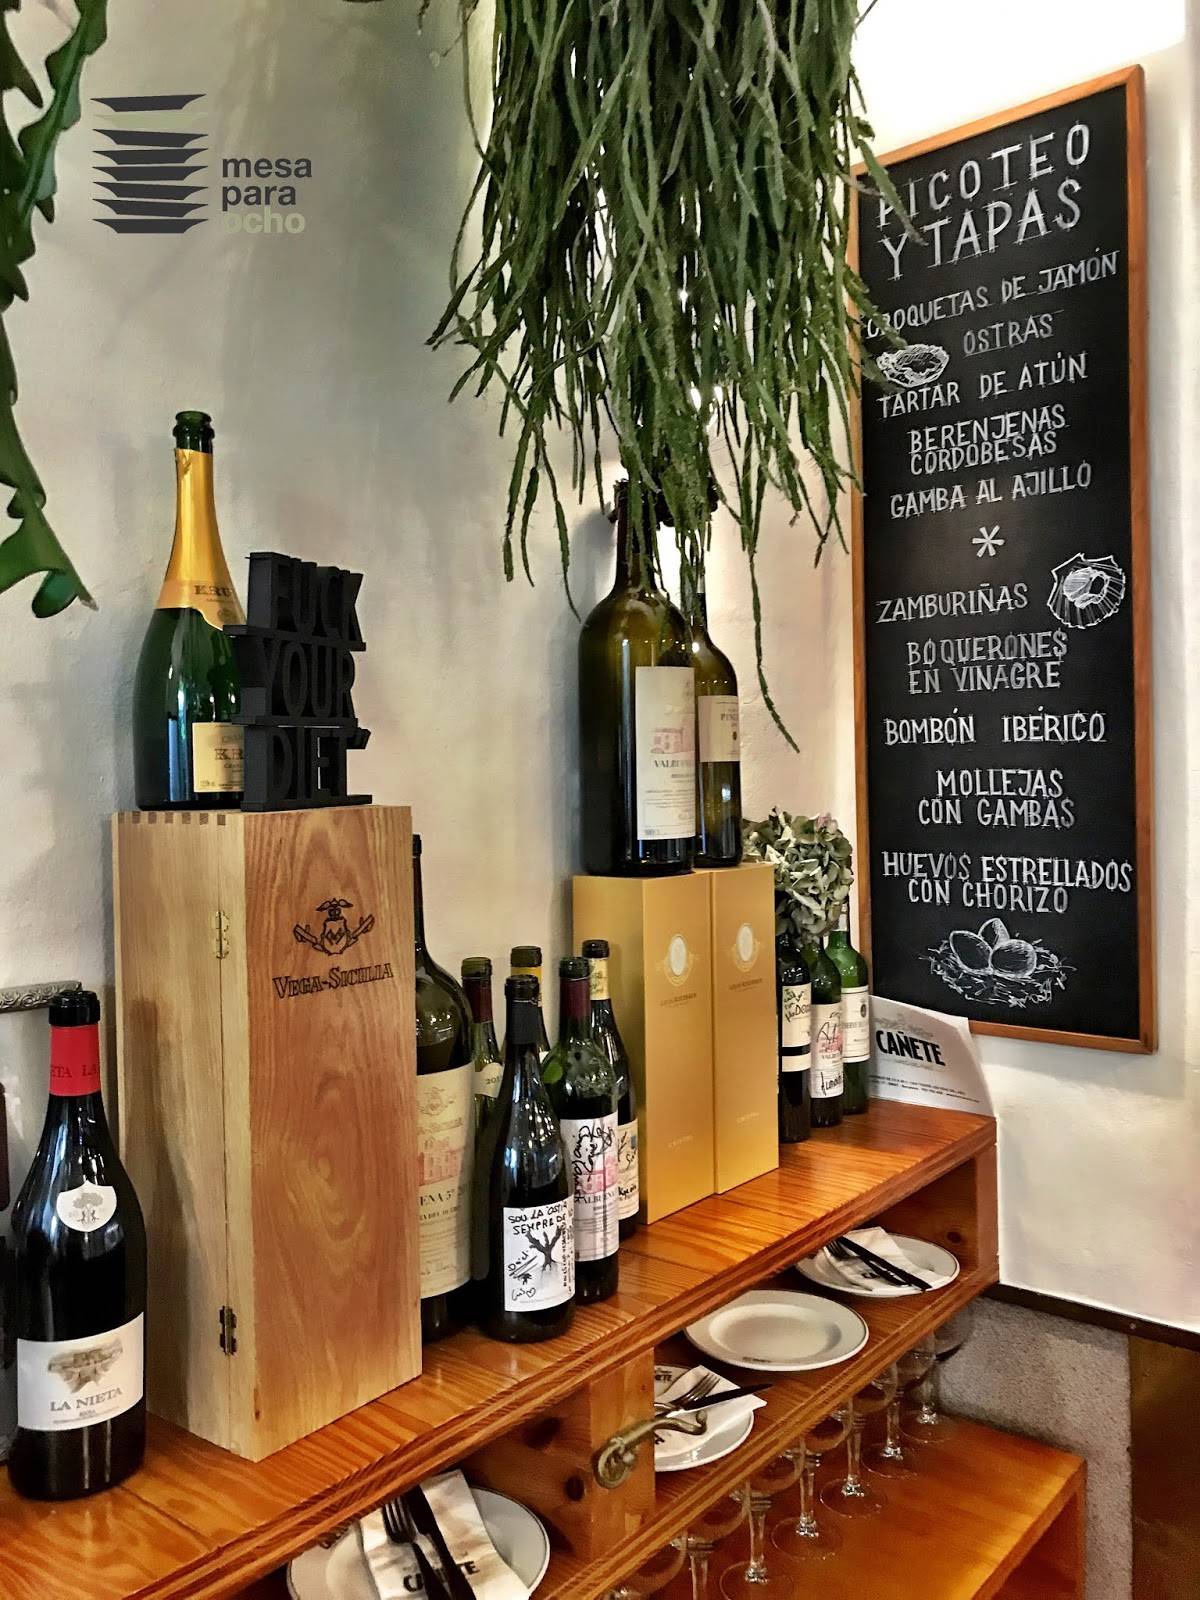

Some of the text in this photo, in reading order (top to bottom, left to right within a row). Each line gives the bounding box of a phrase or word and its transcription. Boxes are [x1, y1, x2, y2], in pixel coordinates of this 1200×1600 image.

[878, 177, 1082, 280] Y TAPAS
[1002, 276, 1026, 303] DE
[1037, 247, 1120, 293] JAMÓN
[963, 313, 1054, 356] OSTRAS
[877, 351, 1089, 419] TARTAR DE ATÚN
[909, 404, 1066, 453] BERENJENAS
[911, 430, 1057, 475] CORDOBESAS
[890, 462, 1092, 519] GAMBA AL AJILLO
[876, 582, 1028, 623] ZAMBURIÑAS
[907, 629, 1069, 667] BOQUERONES
[909, 661, 1061, 694] EN VINAGRE
[884, 705, 1106, 745] BOMBÓN IBÉRICO
[936, 768, 1064, 799] MOLLEJAS
[918, 797, 1075, 829] CON GAMBAS
[883, 851, 1134, 892] HUEVOS ESTRELLADOS
[908, 878, 1069, 913] CON CHORIZO
[876, 1031, 945, 1066] CAÑETE
[50, 1387, 123, 1412] LA NIETA
